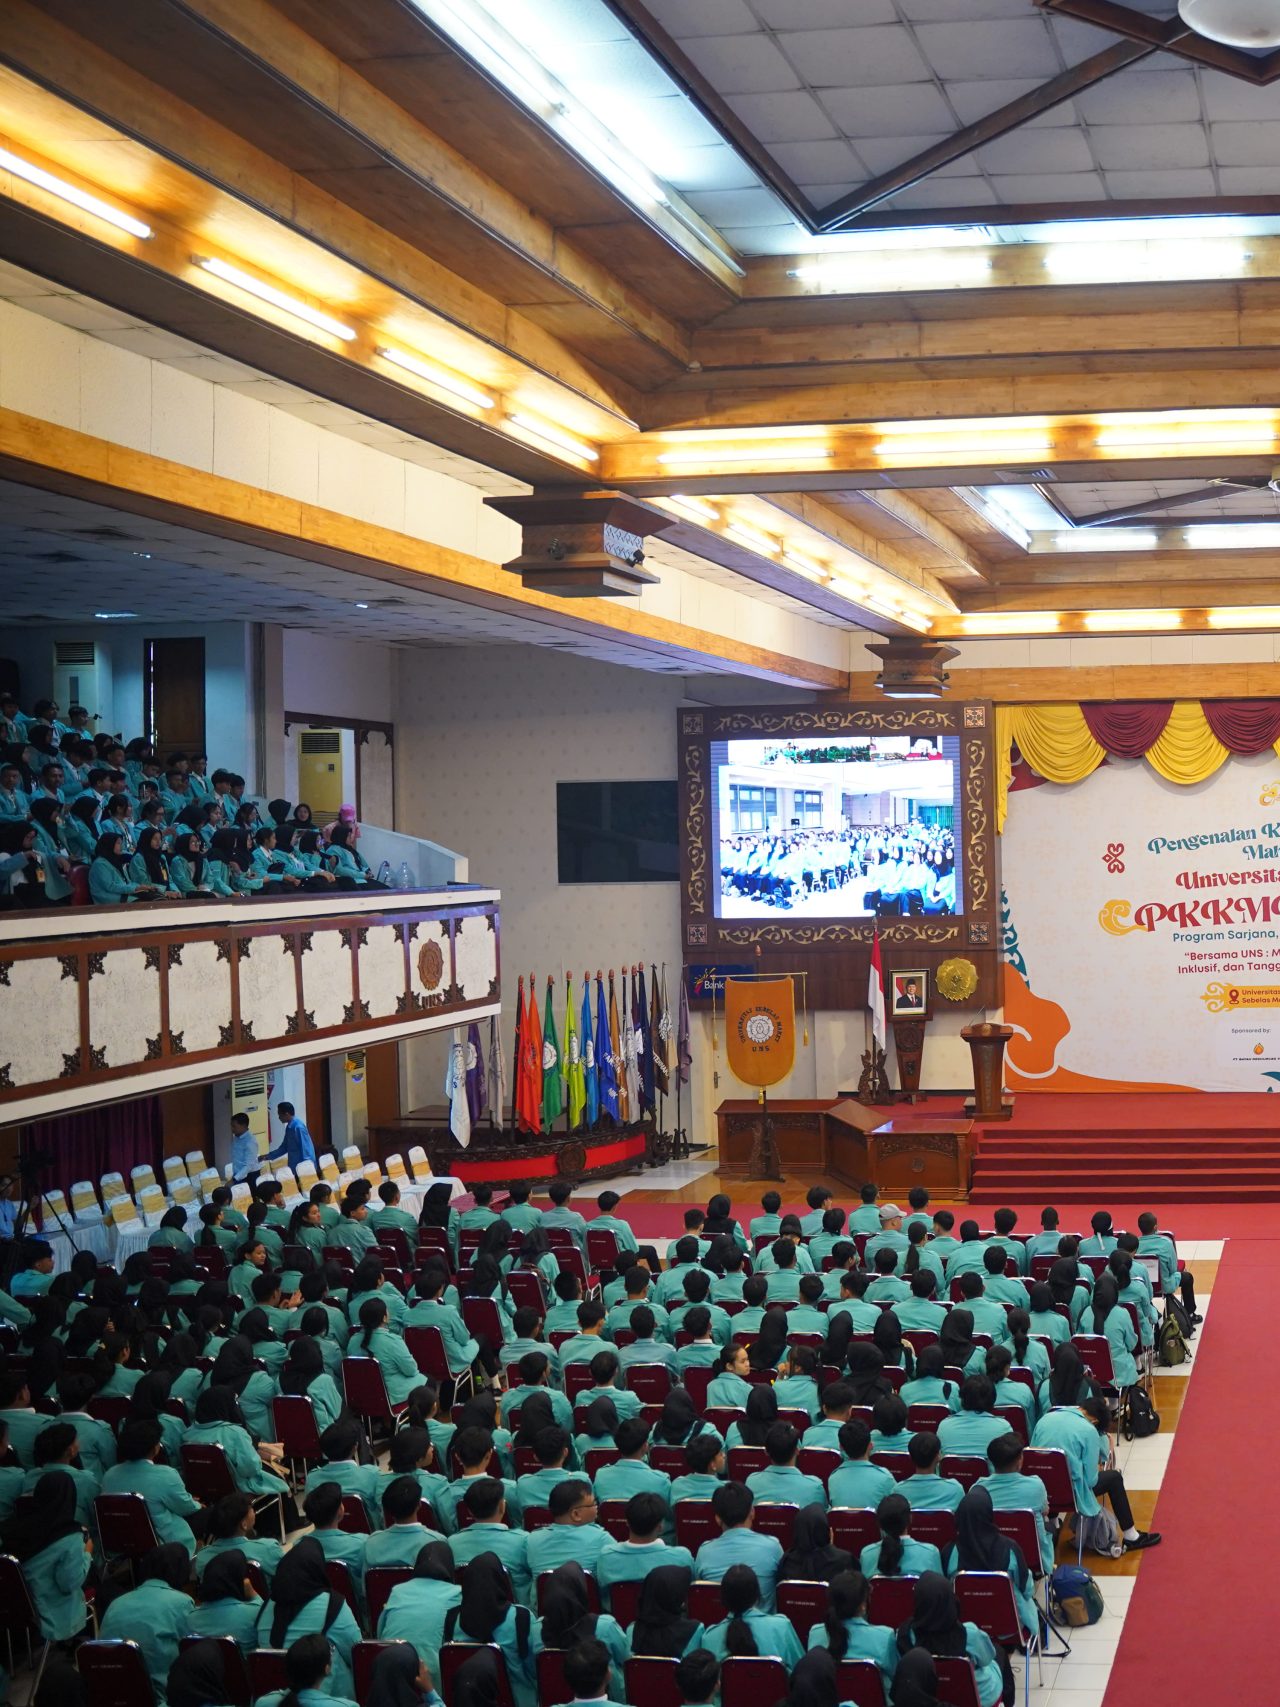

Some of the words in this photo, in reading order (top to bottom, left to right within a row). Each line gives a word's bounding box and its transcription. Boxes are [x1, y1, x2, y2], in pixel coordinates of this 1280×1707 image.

[1147, 827, 1257, 855] Pengenalan
[1173, 931, 1225, 944] Program
[1228, 928, 1279, 941] Sarjana,
[1241, 949, 1264, 958] UNS
[1178, 963, 1221, 974] Inklusif,
[1222, 962, 1245, 972] dan
